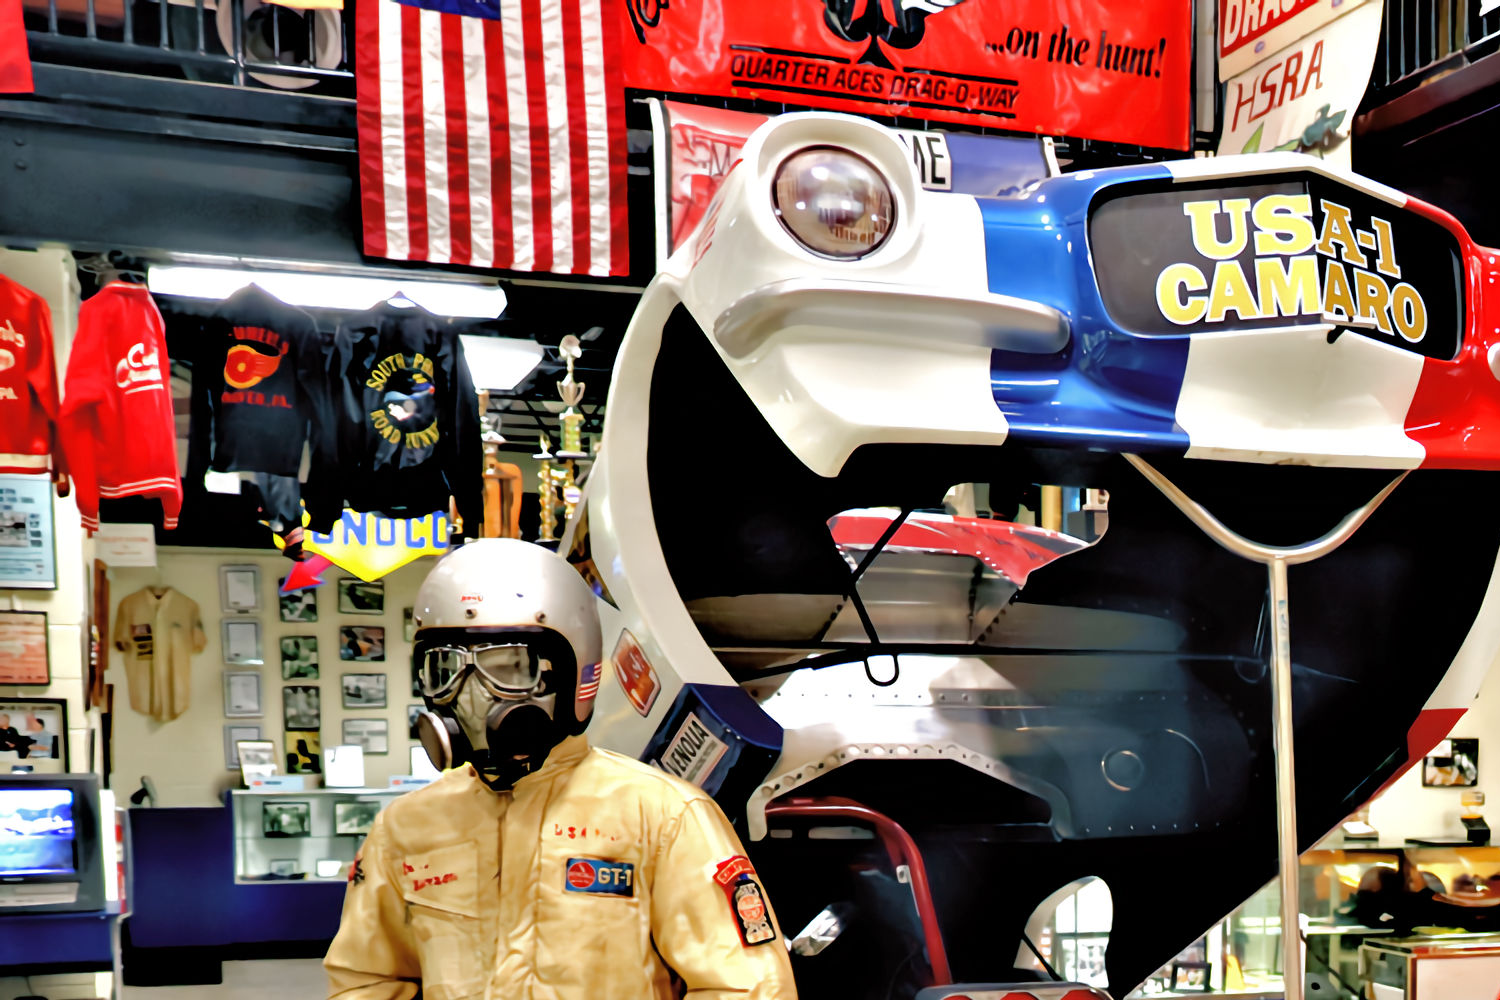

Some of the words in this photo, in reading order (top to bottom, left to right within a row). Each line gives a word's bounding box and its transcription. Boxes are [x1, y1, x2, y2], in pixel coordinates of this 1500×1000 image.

[1048, 25, 1089, 65] the
[1098, 30, 1167, 79] hunt!
[730, 54, 828, 87] QUARTER
[832, 68, 884, 96] ACES
[890, 75, 1019, 109] DRAG-O-WAY
[1183, 194, 1401, 279] USA-1
[1156, 255, 1428, 343] CAMARO
[366, 353, 405, 391] SOUTH
[665, 719, 710, 777] VENOLIA
[598, 867, 632, 887] GT-1
